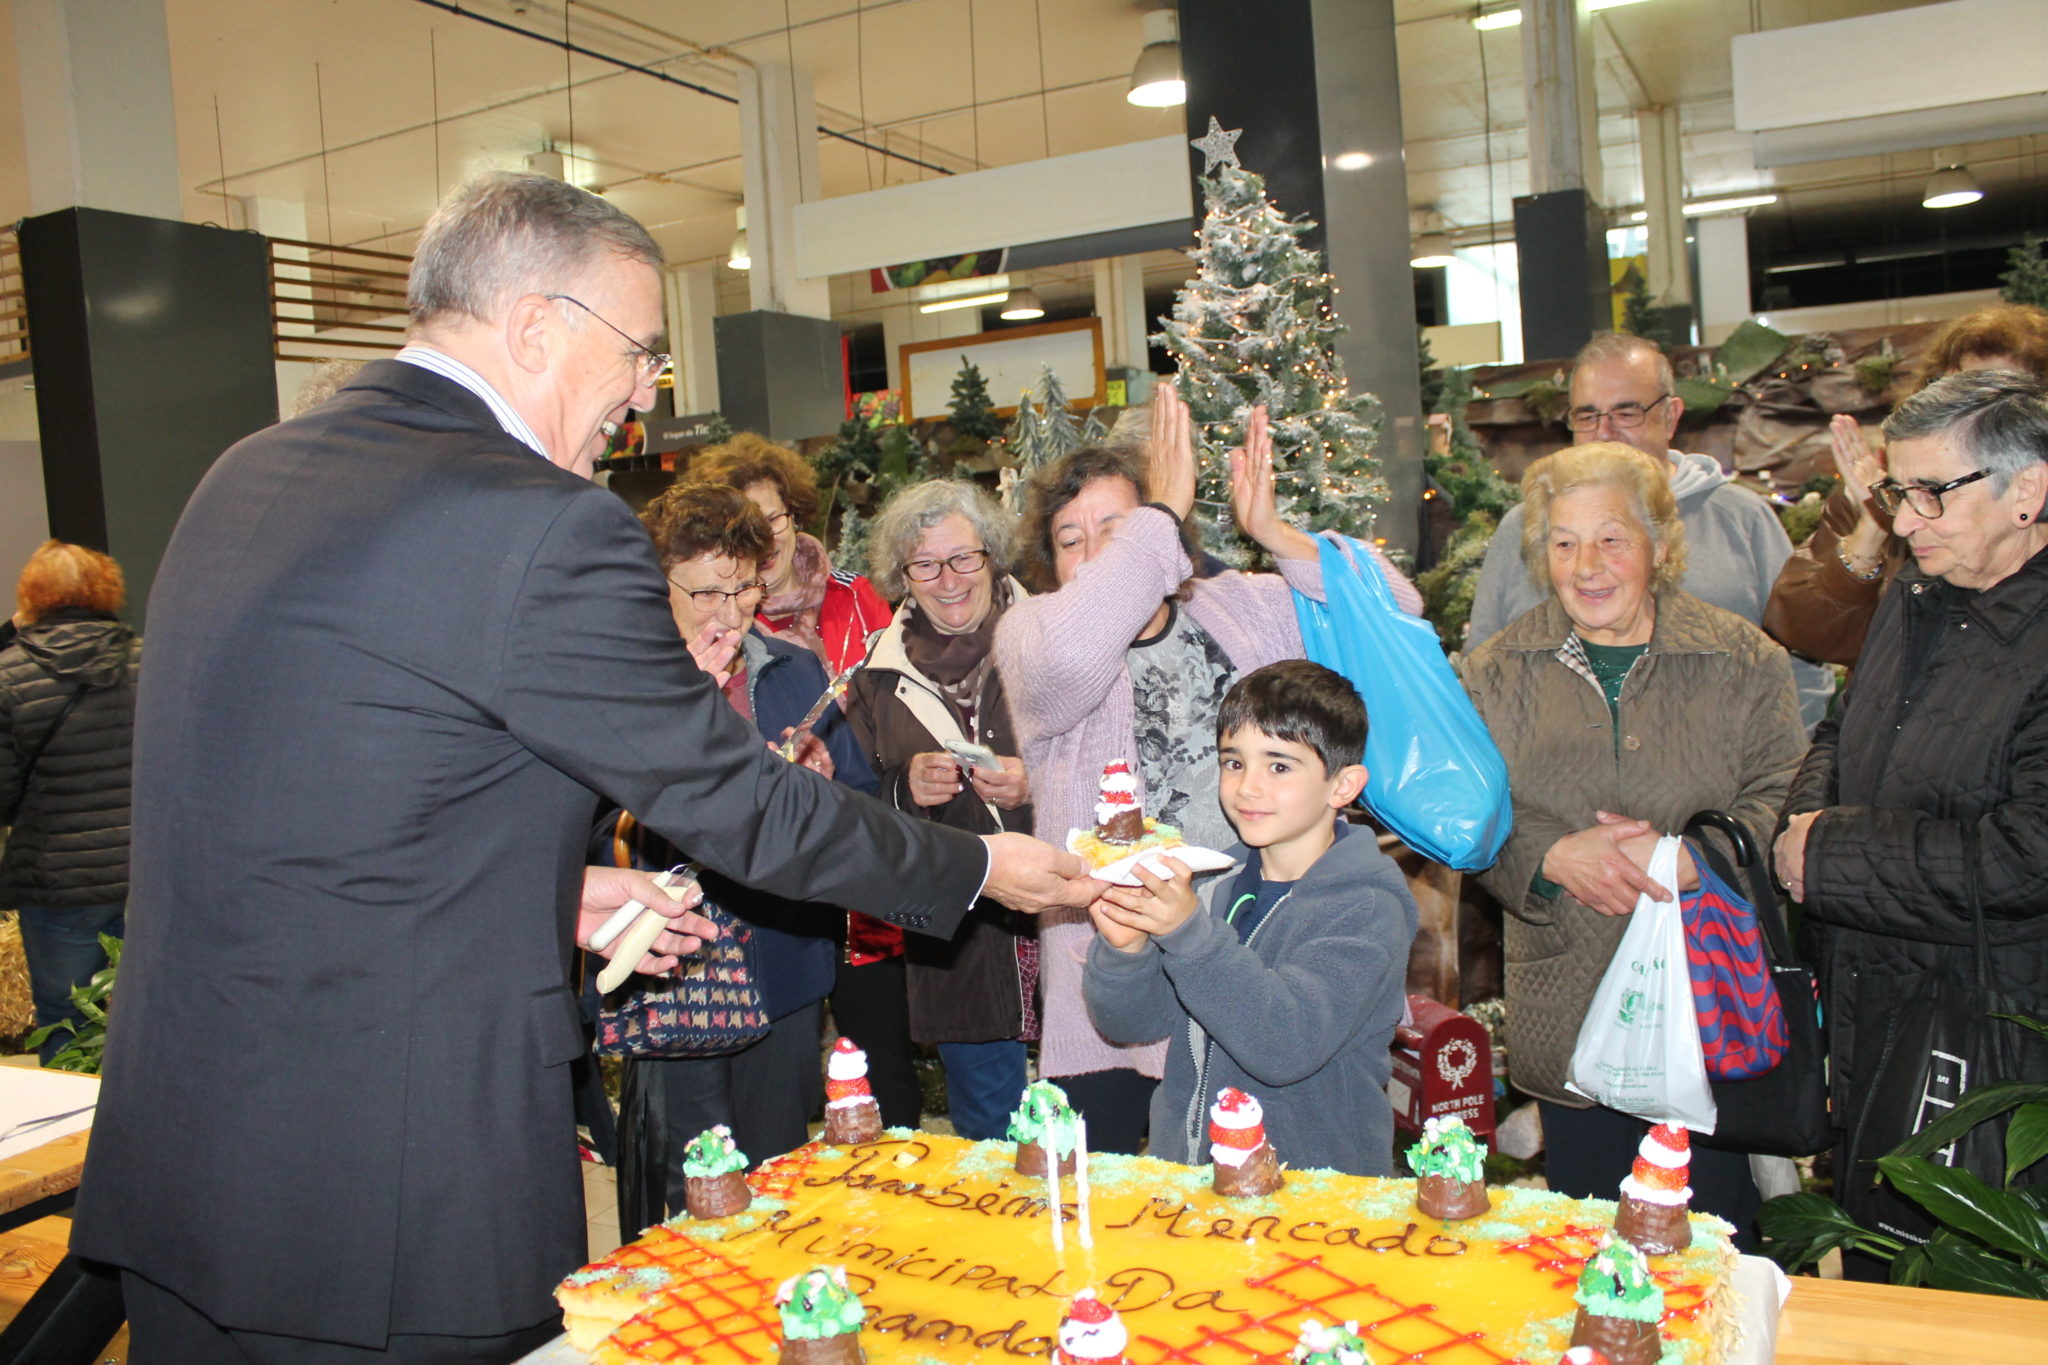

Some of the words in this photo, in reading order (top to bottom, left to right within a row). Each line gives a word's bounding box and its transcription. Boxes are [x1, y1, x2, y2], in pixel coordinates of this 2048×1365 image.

[1431, 1099, 1461, 1114] NORTH
[1462, 1094, 1485, 1107] POLE
[1105, 1267, 1249, 1313] Da
